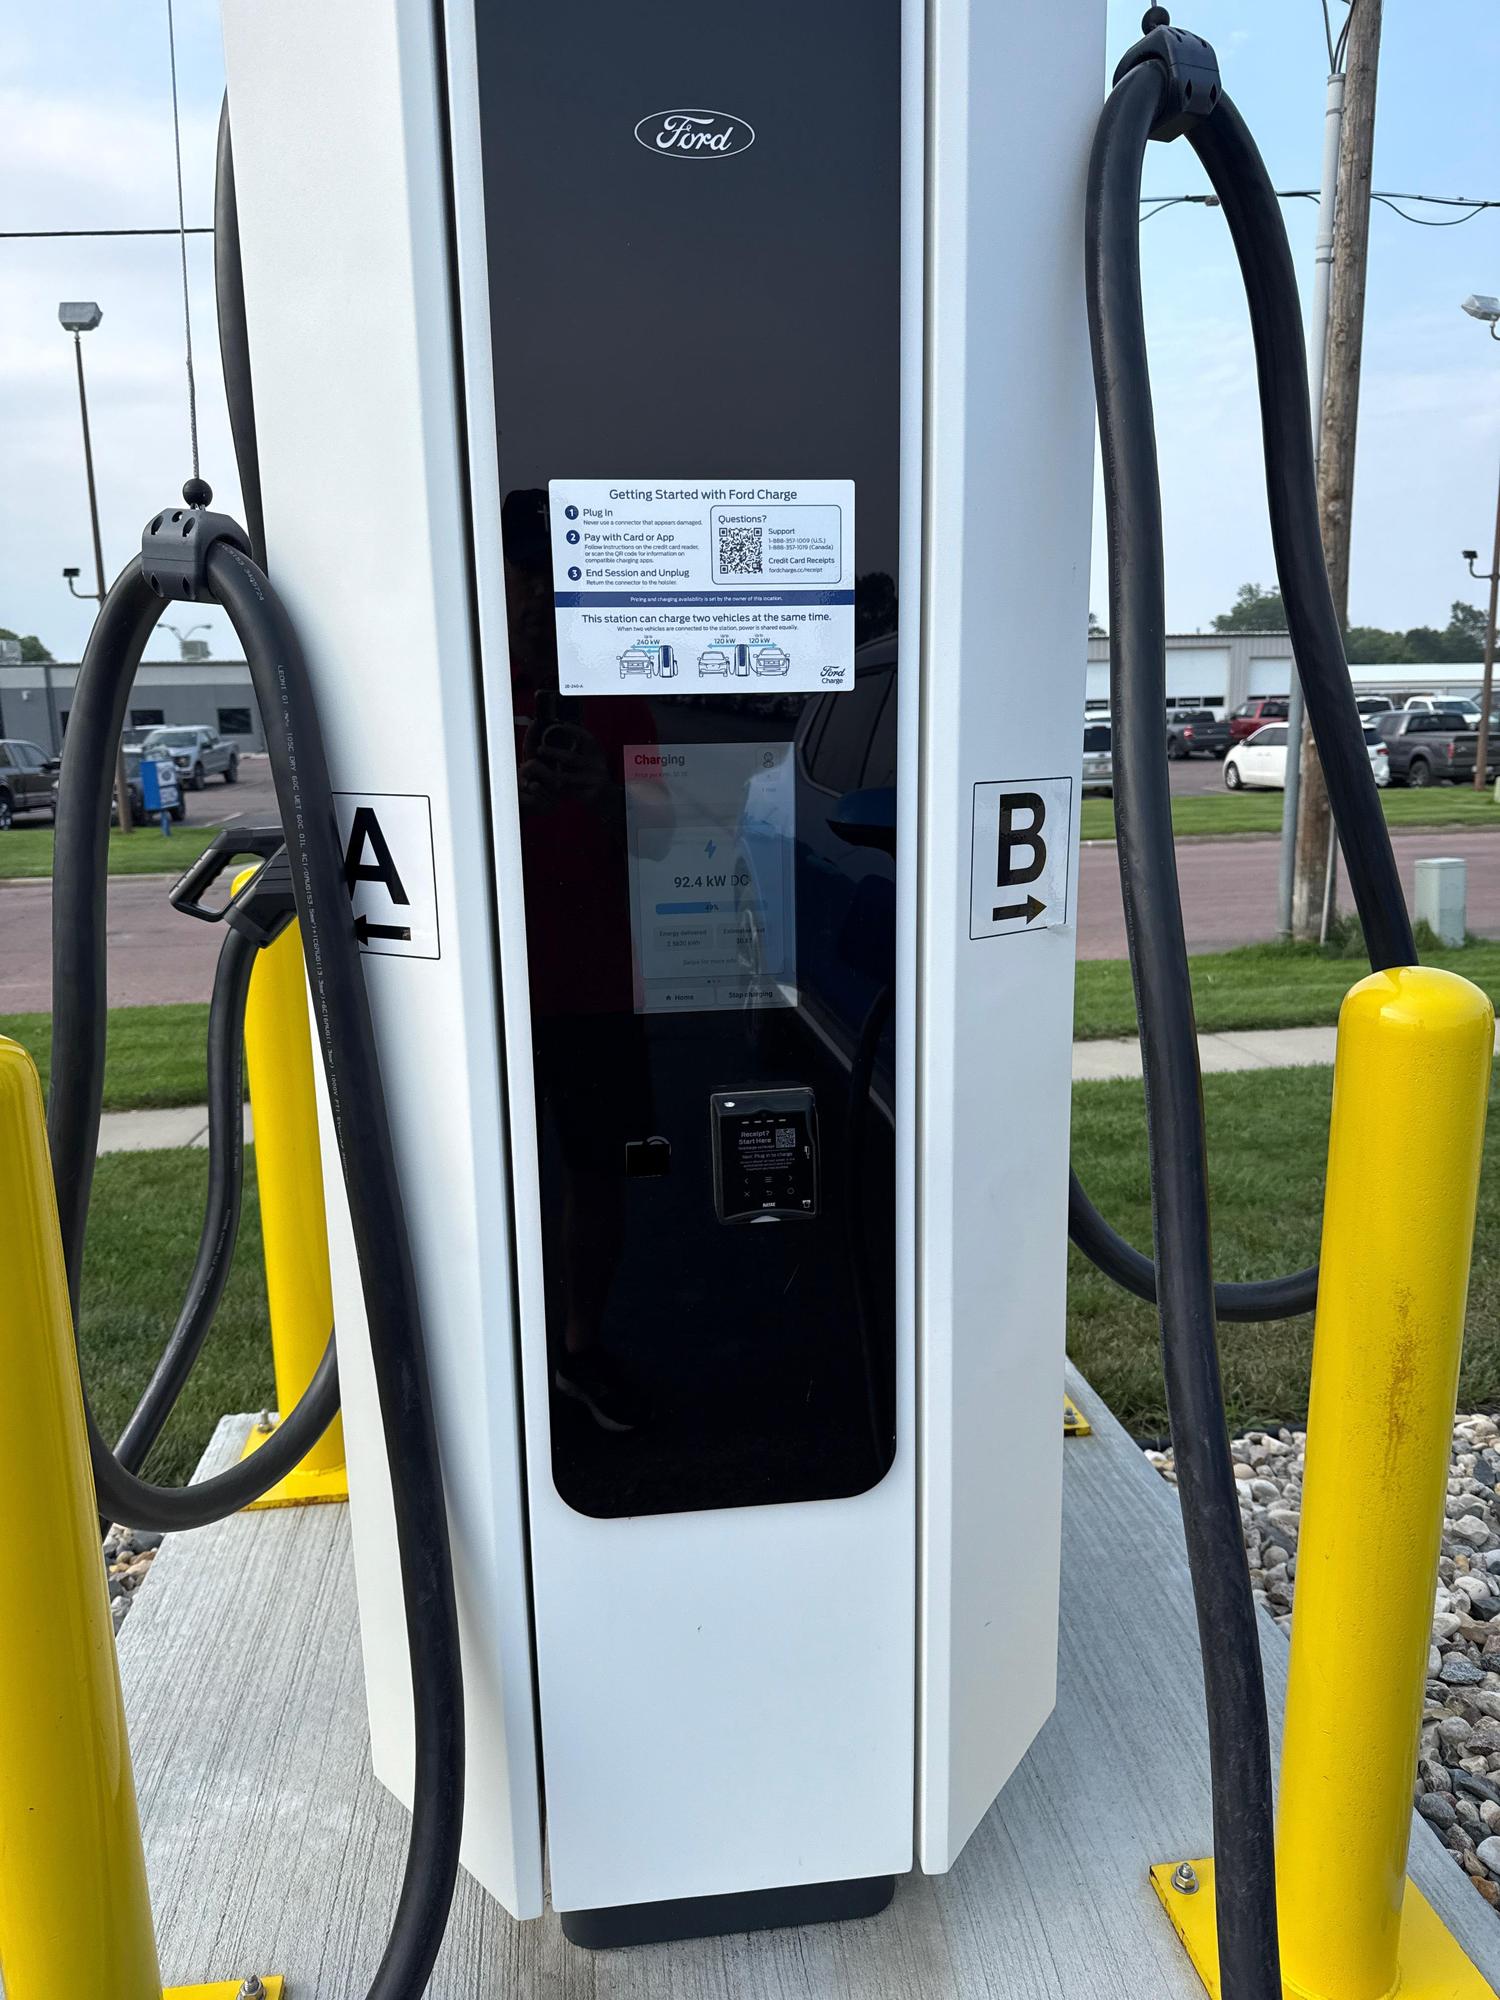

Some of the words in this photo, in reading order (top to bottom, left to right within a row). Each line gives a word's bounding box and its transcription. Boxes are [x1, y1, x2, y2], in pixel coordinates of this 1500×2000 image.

[656, 115, 733, 150] Ford
[610, 489, 652, 501] Getting
[655, 489, 698, 499] Started
[701, 489, 726, 499] with
[729, 489, 754, 499] Ford
[757, 489, 797, 501] Charge
[583, 509, 603, 518] Plug
[718, 515, 767, 524] Questions?
[584, 534, 600, 542] Pay
[603, 533, 621, 541] with
[623, 533, 644, 541] Card
[657, 534, 674, 542] App
[586, 569, 603, 577] End
[605, 569, 638, 577] Session
[640, 569, 657, 577] and
[659, 569, 689, 578] Unplug
[582, 614, 602, 623] This
[604, 614, 637, 623] station
[659, 614, 690, 624] charge
[693, 614, 710, 622] two
[712, 613, 750, 622] vehicles
[752, 614, 762, 622] at
[764, 613, 779, 622] the
[808, 613, 831, 621] time.
[820, 665, 845, 677] Ford
[634, 754, 685, 766] Charging
[288, 755, 296, 772] DRY
[297, 832, 306, 848] OIL
[997, 792, 1047, 887] B
[345, 807, 410, 905] A
[674, 876, 702, 888] 92.4
[706, 875, 726, 887] kW
[731, 874, 750, 887] DC
